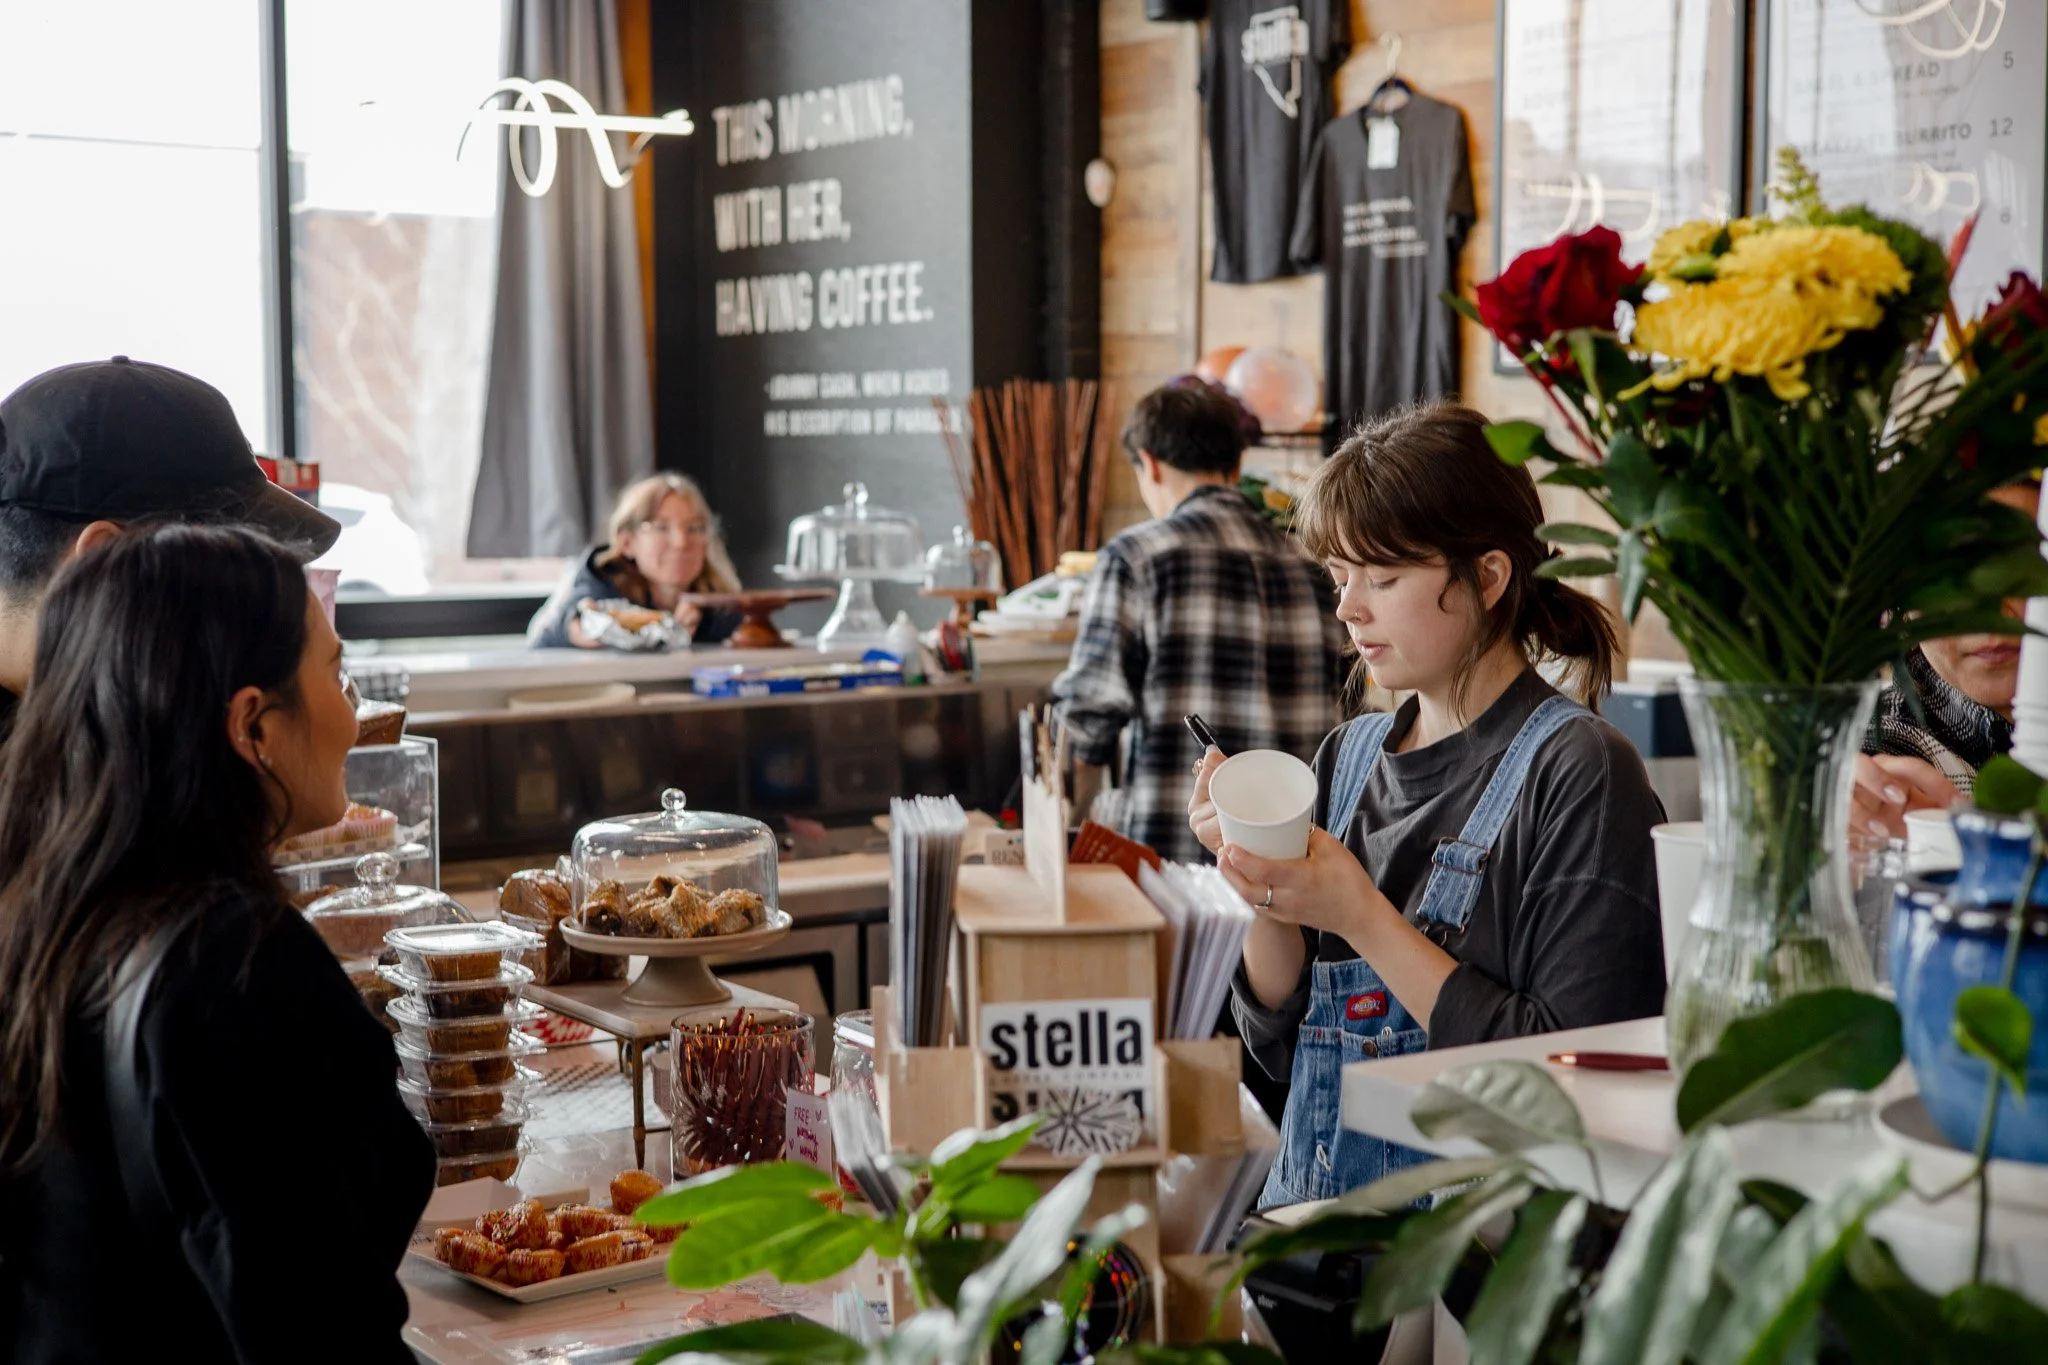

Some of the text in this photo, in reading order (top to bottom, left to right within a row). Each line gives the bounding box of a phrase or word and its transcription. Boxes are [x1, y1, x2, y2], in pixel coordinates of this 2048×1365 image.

[2002, 51, 2015, 70] 5
[711, 98, 774, 167] THIS
[1989, 116, 2014, 138] 12
[714, 185, 782, 252] WITH
[715, 261, 934, 337] HAVING COFFEE.
[991, 1010, 1144, 1071] stella
[793, 1106, 810, 1125] FREE
